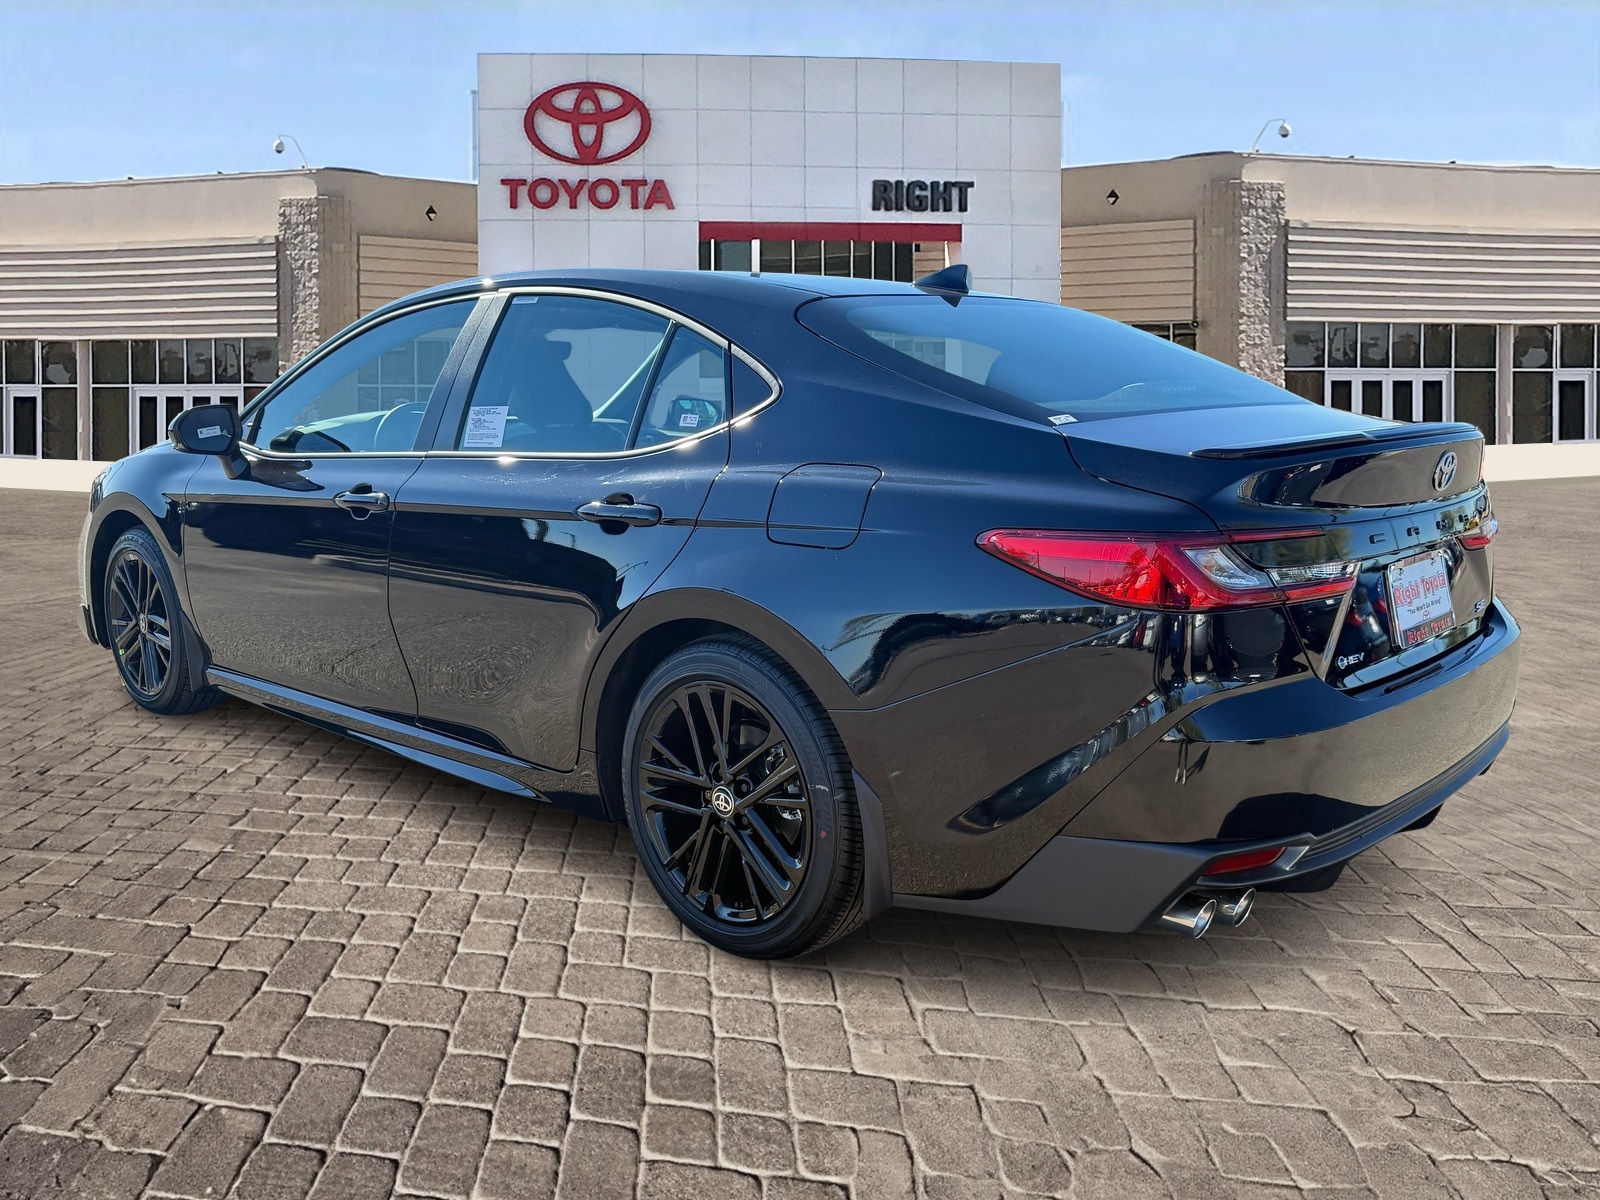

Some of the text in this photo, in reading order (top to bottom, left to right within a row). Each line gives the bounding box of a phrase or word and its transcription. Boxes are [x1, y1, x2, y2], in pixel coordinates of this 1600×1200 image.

[500, 178, 675, 209] TOYOTA
[871, 179, 975, 212] RIGHT
[1393, 571, 1447, 607] Right Toyota
[1407, 627, 1429, 644] Right
